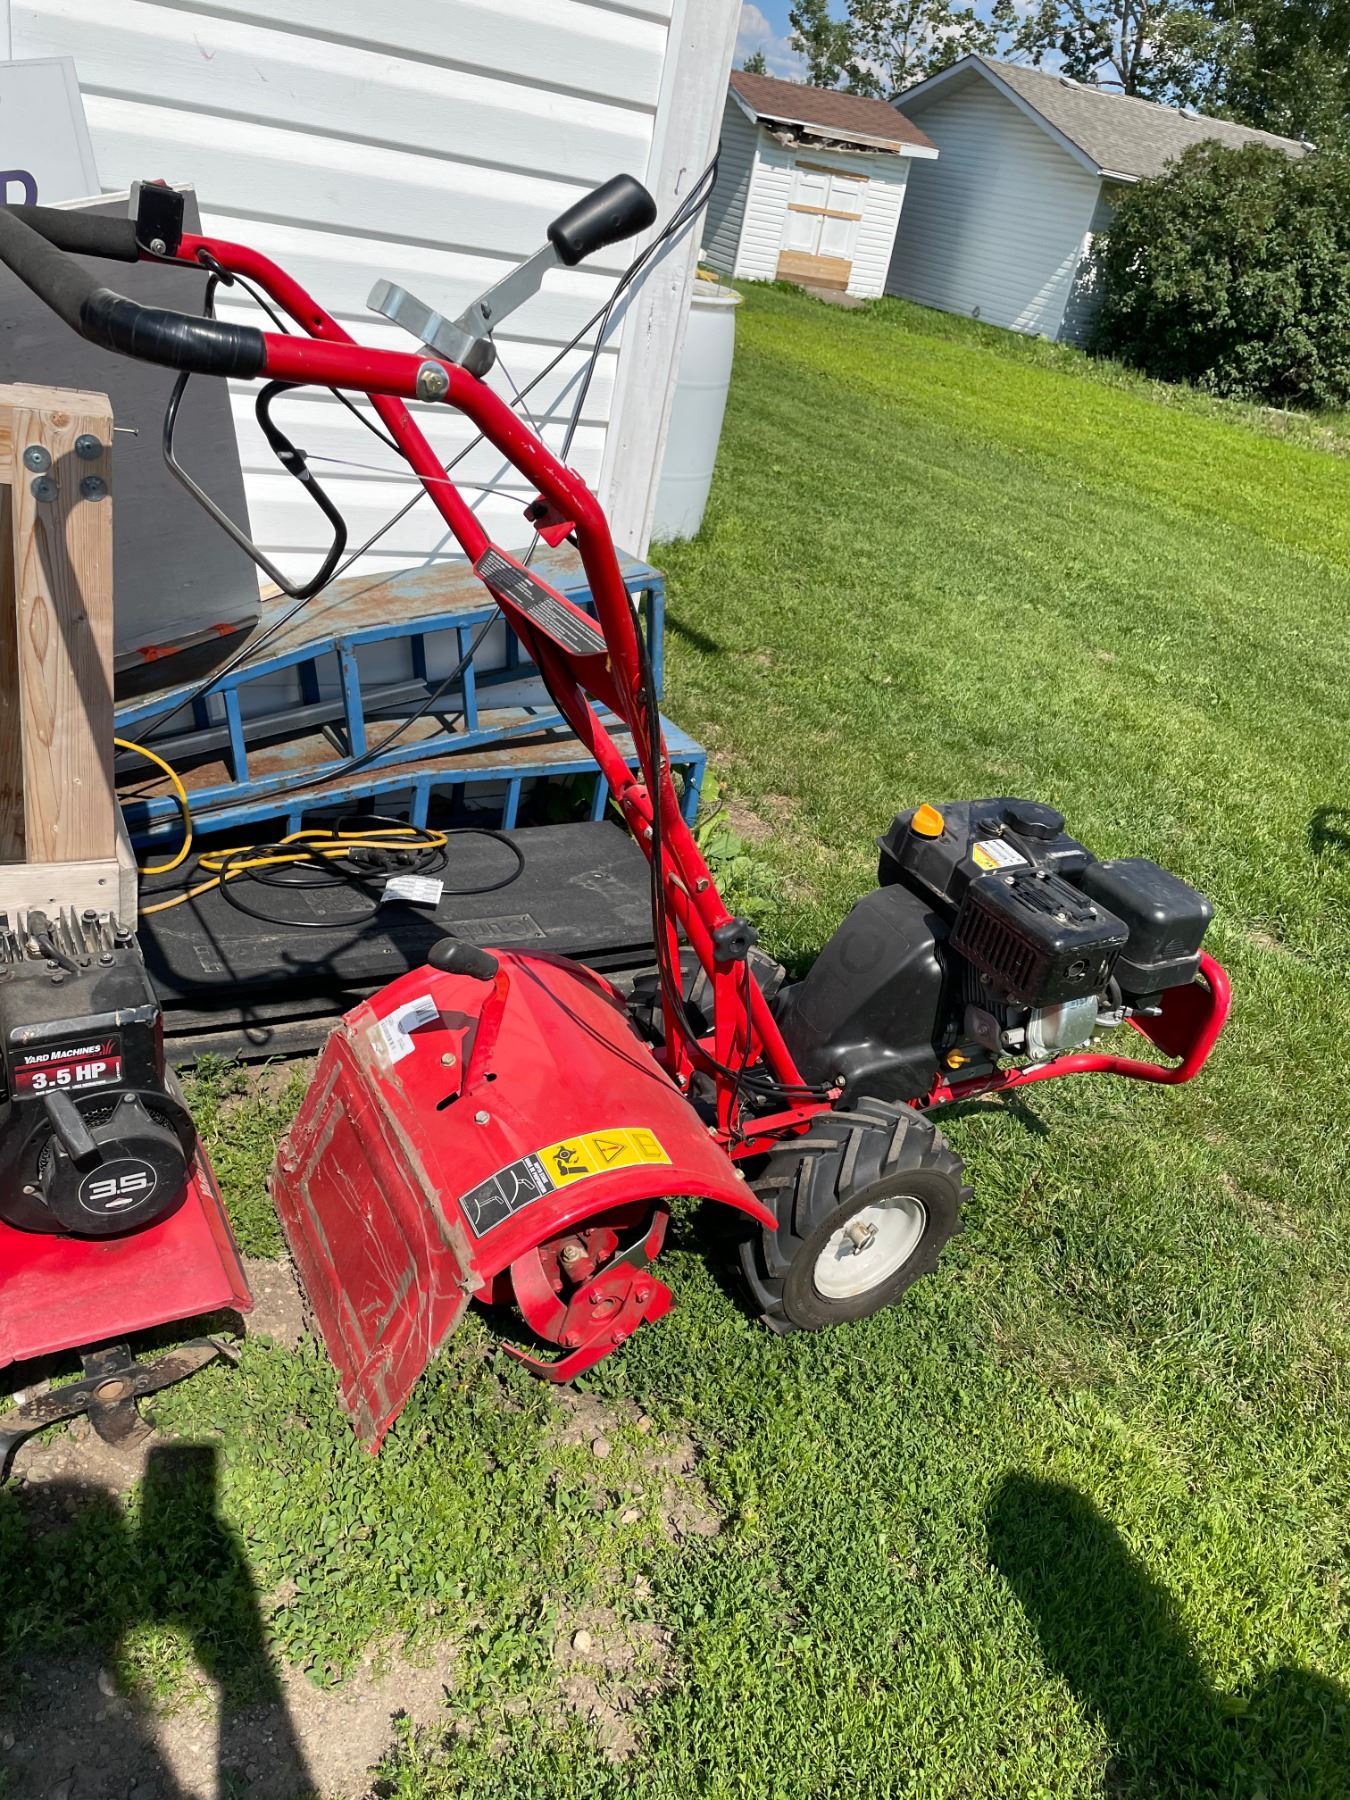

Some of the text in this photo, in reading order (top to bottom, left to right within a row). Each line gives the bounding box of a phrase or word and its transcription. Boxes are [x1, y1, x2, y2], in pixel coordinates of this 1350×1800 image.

[23, 1045, 101, 1065] YARD MACHINES
[32, 1069, 71, 1088] 3.5
[76, 1062, 106, 1081] HP
[89, 1172, 147, 1199] 3.5
